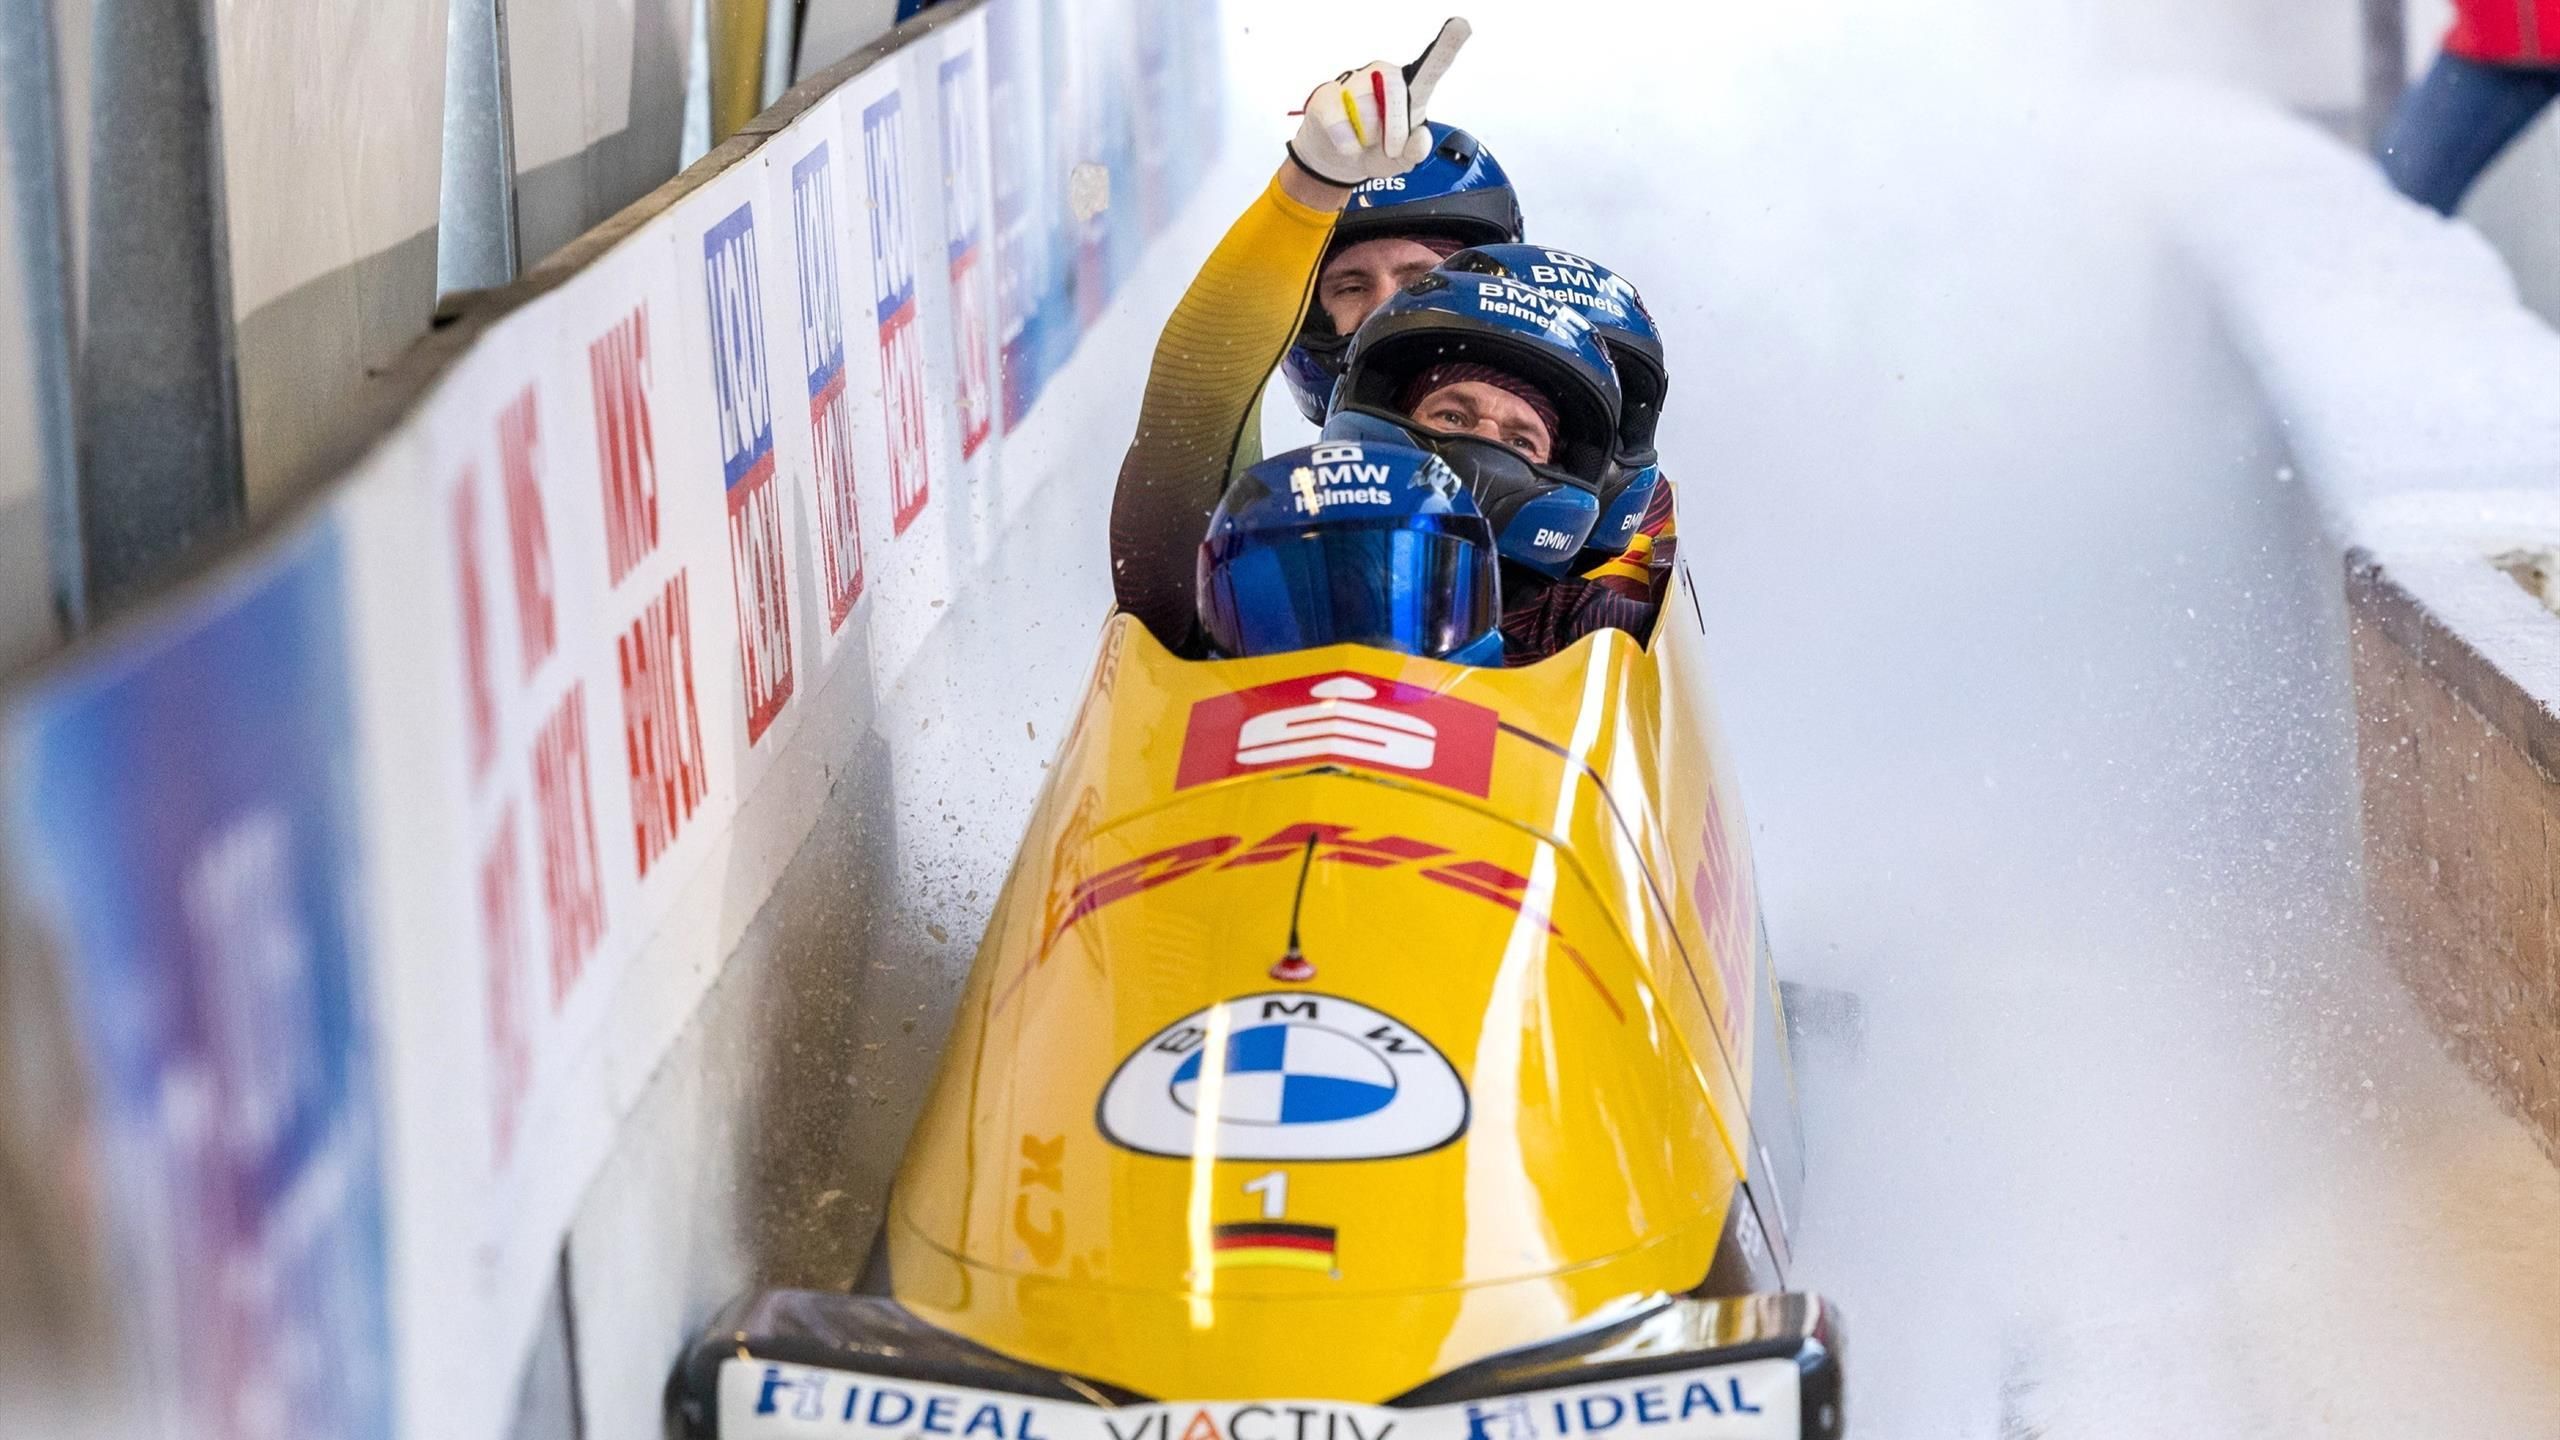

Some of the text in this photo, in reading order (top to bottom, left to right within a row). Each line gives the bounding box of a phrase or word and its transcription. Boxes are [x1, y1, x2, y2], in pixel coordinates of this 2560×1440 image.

[1478, 282, 1565, 319] BMW
[1480, 297, 1570, 341] helmets
[706, 226, 770, 463] LIQUI
[730, 473, 790, 719] MOLY
[1155, 1000, 1425, 1055] BMW
[1243, 1170, 1289, 1220] 1
[843, 1384, 1049, 1440] IDEAL
[1554, 1376, 1763, 1435] IDEAL
